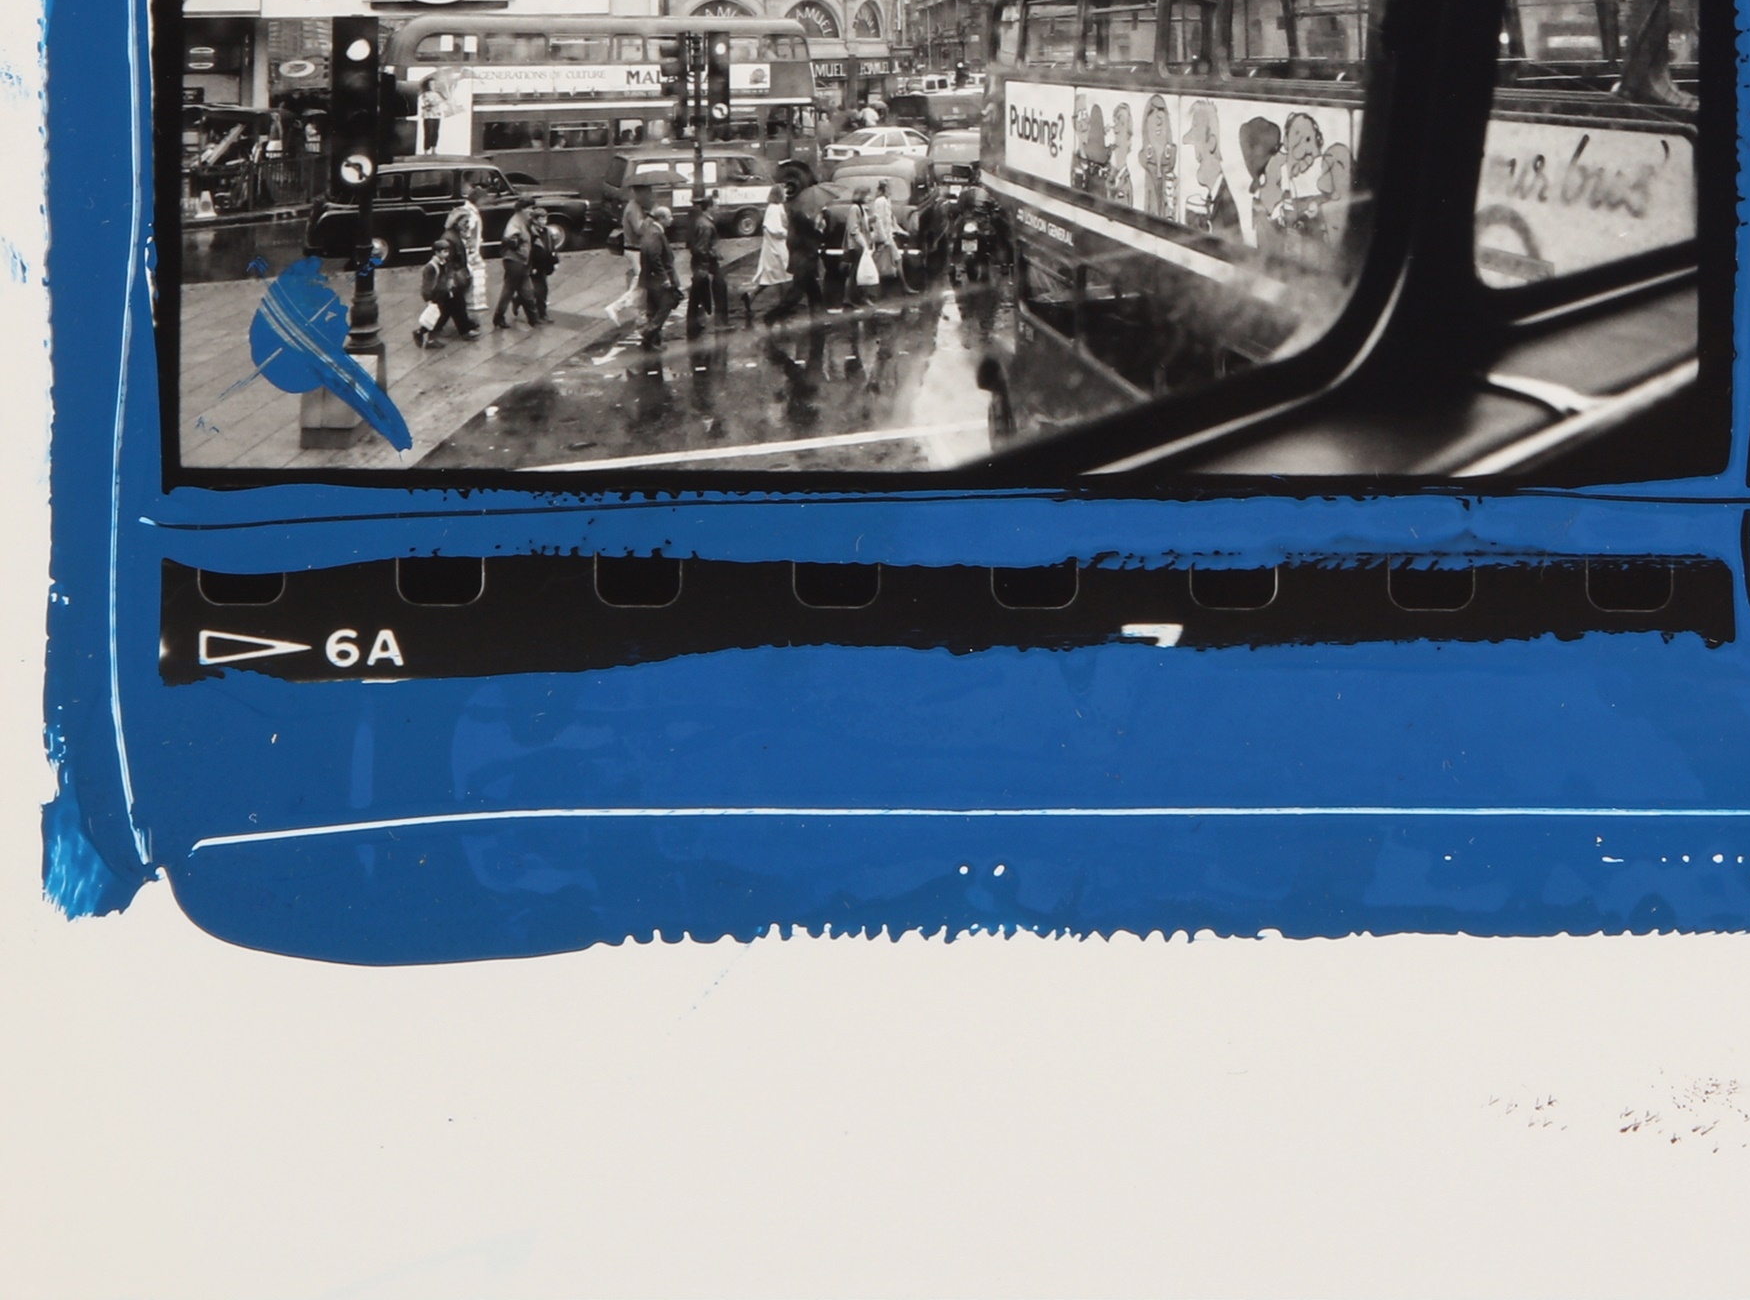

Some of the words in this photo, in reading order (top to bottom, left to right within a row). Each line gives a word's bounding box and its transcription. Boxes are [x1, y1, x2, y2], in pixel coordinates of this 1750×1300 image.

[565, 69, 607, 80] CULTURE
[1009, 102, 1066, 159] Pubbing?
[324, 629, 404, 668] 6A
